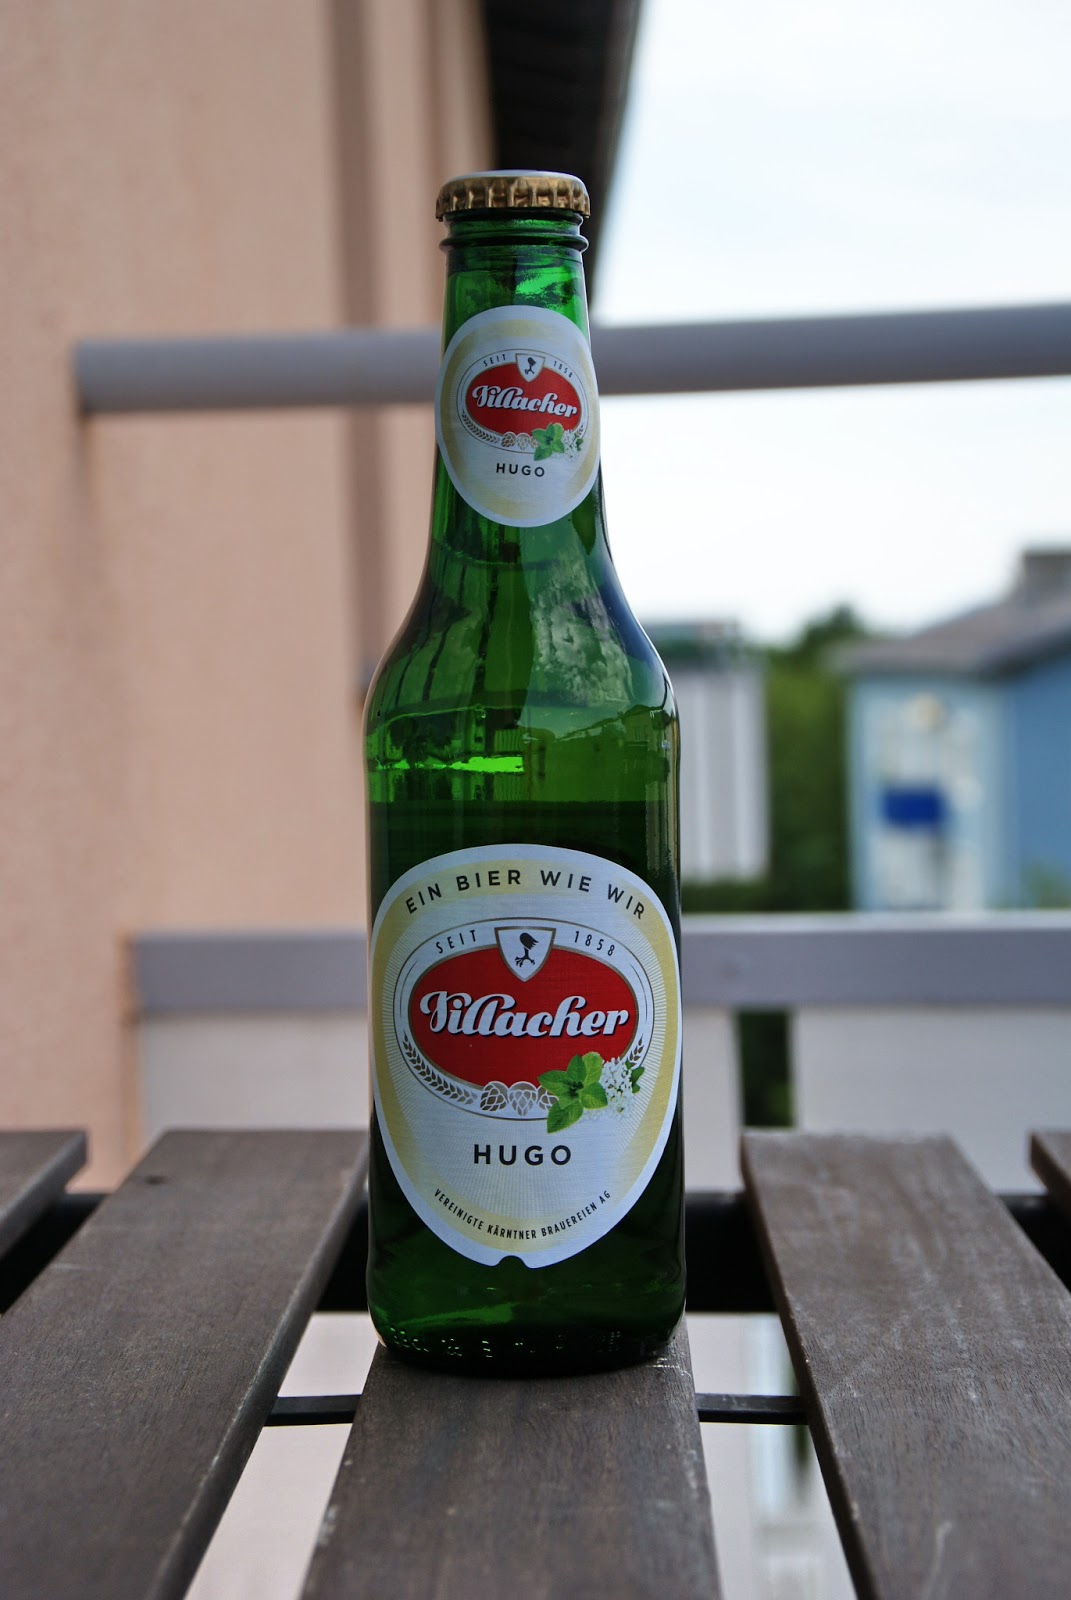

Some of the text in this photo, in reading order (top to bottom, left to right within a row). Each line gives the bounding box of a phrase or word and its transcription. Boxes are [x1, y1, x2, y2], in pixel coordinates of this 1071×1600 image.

[483, 353, 574, 378] SEIT 1858
[472, 385, 578, 418] Villacher
[496, 463, 545, 477] HUGO
[405, 869, 645, 919] EIN BIER WIE WIR
[435, 929, 615, 956] SEIT 1858
[419, 990, 629, 1038] Villacher
[473, 1143, 571, 1166] HUGO
[434, 1188, 611, 1240] VEREINIGTE KÄRNTNER BRAUEREIEN AG
